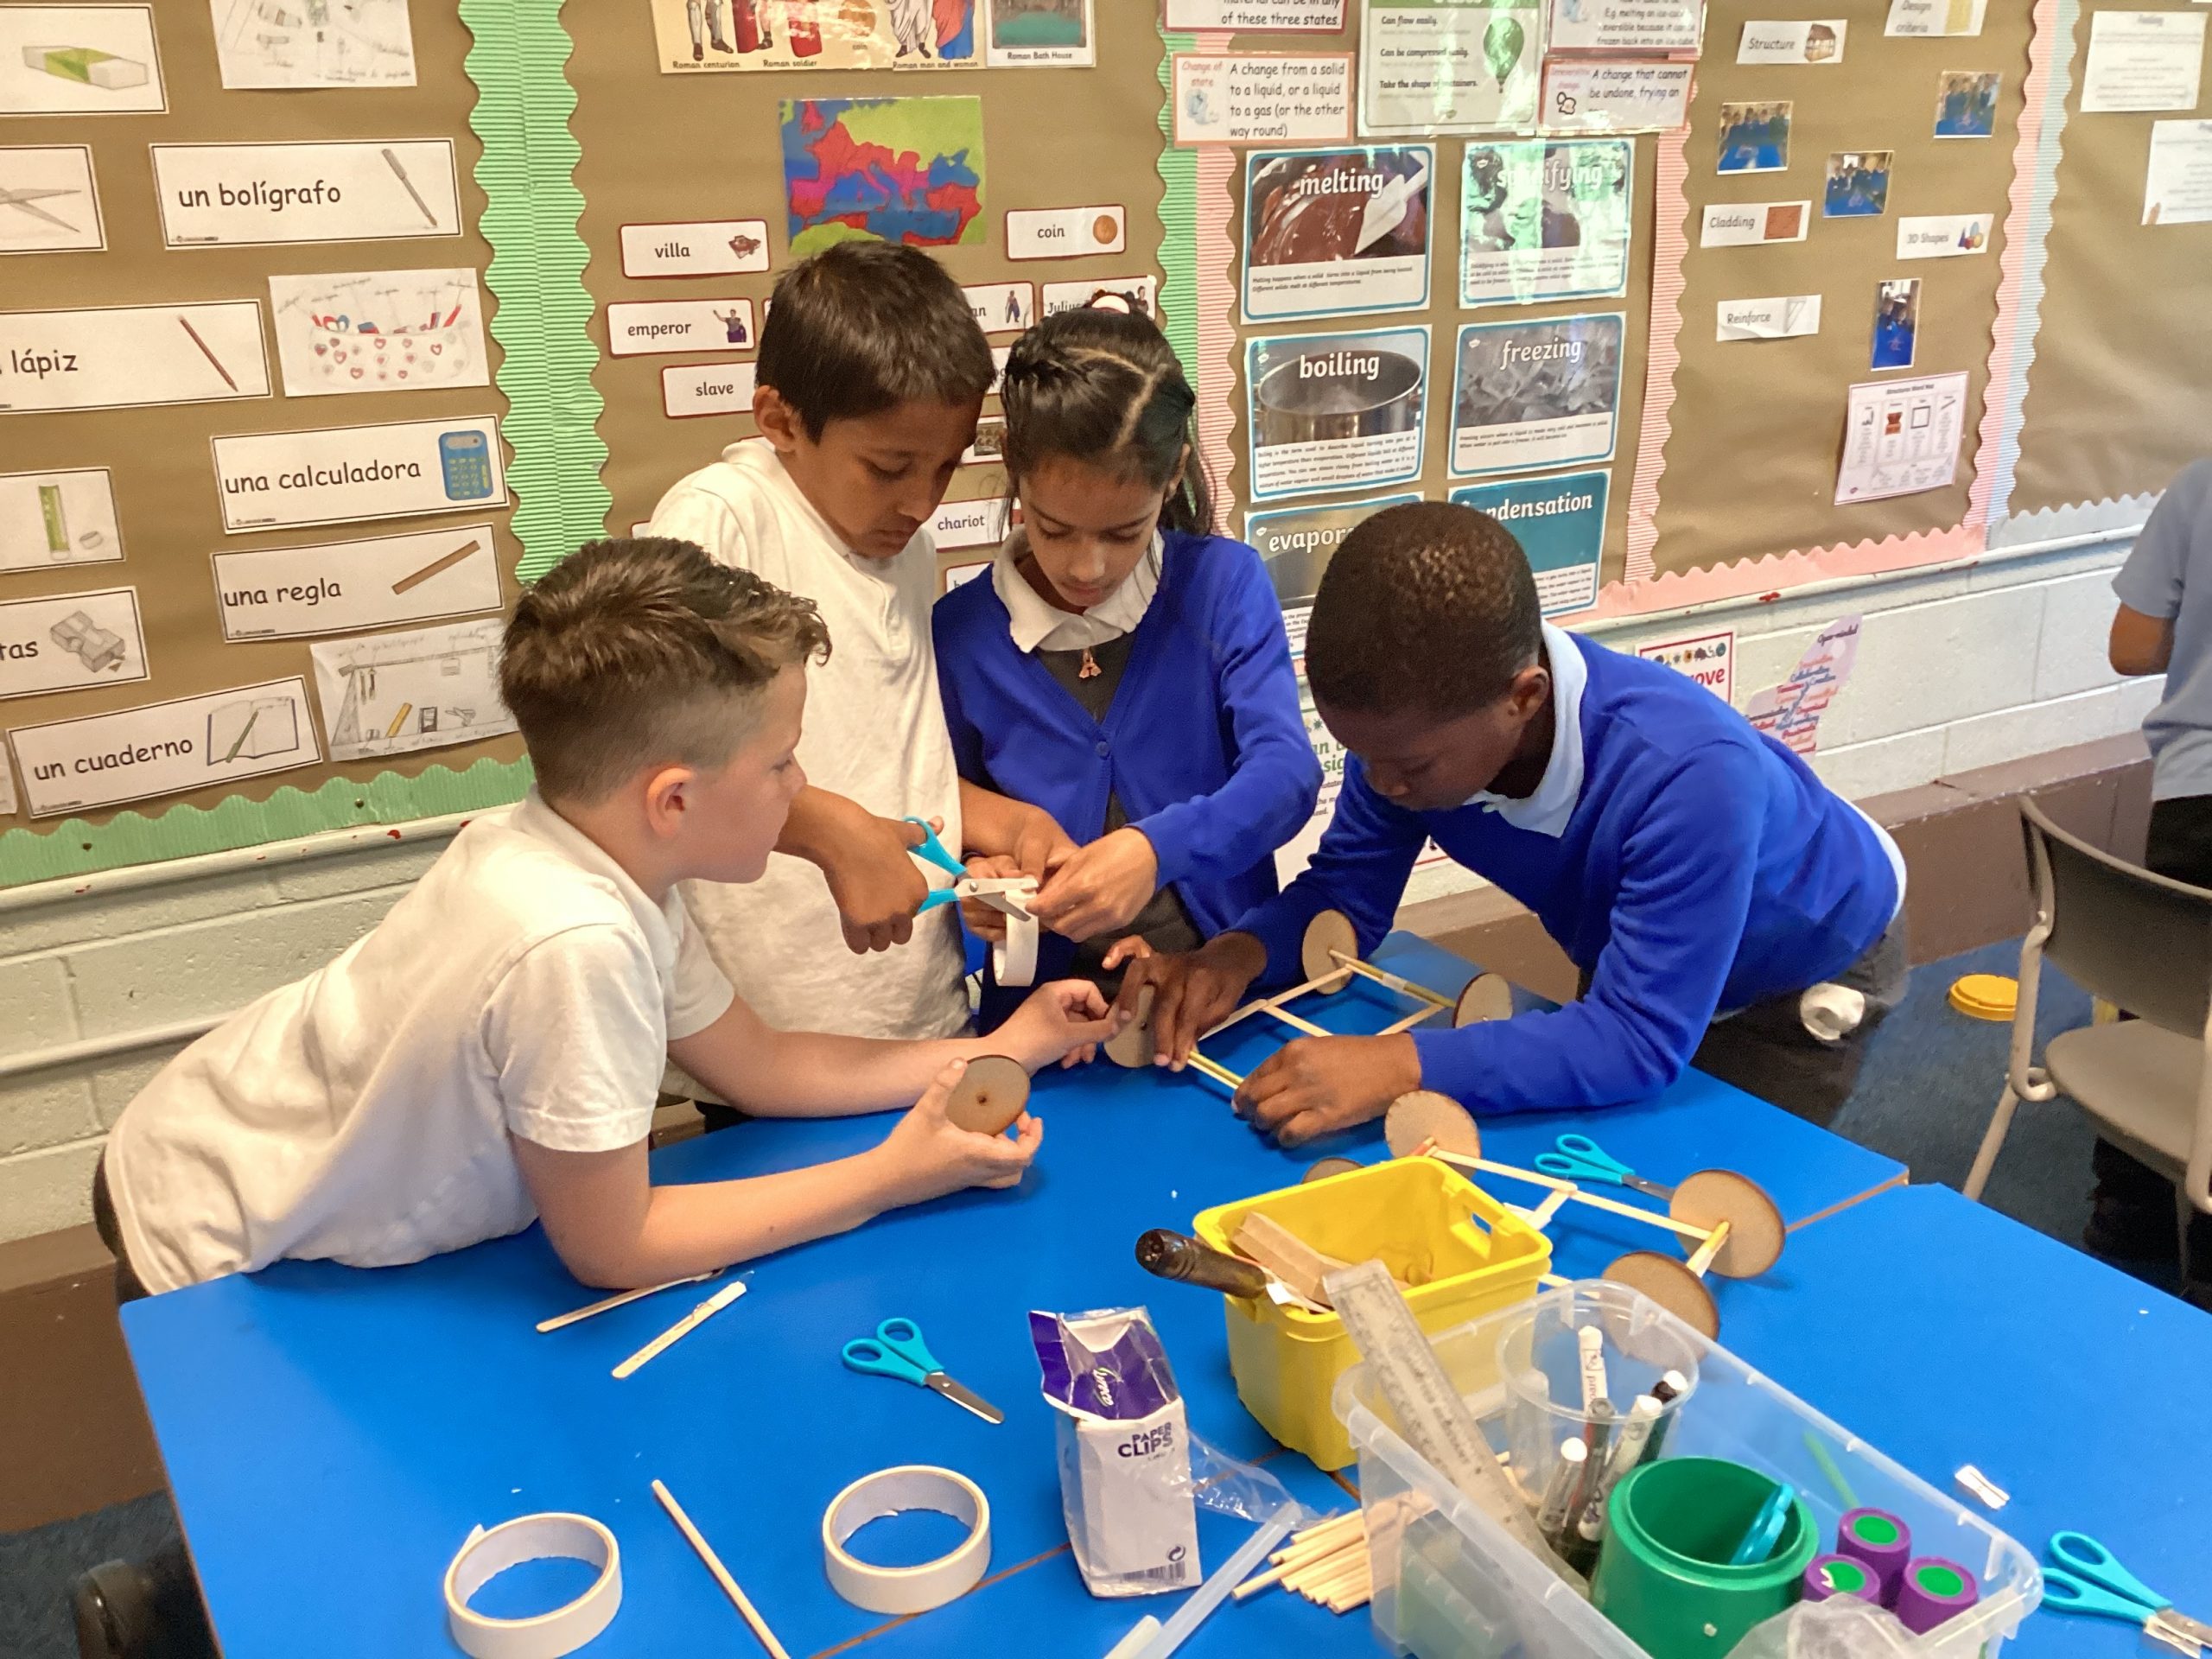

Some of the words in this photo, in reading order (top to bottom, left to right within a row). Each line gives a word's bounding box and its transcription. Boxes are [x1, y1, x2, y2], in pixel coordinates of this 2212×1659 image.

[1221, 11, 1234, 24] of
[1237, 11, 1268, 24] these
[1271, 12, 1300, 25] three
[1748, 38, 1796, 50] Structure
[672, 60, 702, 69] Roman
[1230, 64, 1238, 75] A
[1241, 63, 1279, 79] change
[1282, 62, 1307, 75] from
[1311, 67, 1318, 75] a
[1320, 62, 1345, 75] solid
[1230, 86, 1241, 96] to
[1313, 85, 1340, 99] liquid
[1230, 105, 1241, 116] to
[1254, 107, 1272, 121] gas
[1275, 105, 1291, 118] (or
[1294, 105, 1312, 116] the
[1315, 105, 1344, 116] other
[1230, 127, 1250, 139] way
[1253, 124, 1287, 137] round)
[1299, 167, 1384, 200] melting
[179, 190, 211, 208] un
[219, 179, 341, 213] bolígrafo
[1037, 224, 1065, 238] coin
[1709, 215, 1755, 230] Cladding
[654, 242, 691, 258] villa
[1726, 312, 1771, 327] Reinforce
[627, 322, 691, 340] emperor
[1499, 336, 1582, 371] freezing
[11, 347, 79, 380] lápiz
[1299, 352, 1380, 381] boiling
[696, 381, 734, 397] slave
[225, 475, 270, 494] una
[278, 459, 422, 489] calculadora
[1484, 492, 1593, 521] ndensation
[938, 514, 985, 531] chariot
[1268, 525, 1354, 553] evapor
[224, 589, 269, 607] una
[276, 577, 342, 607] regla
[1692, 667, 1726, 685] ove
[34, 761, 66, 781] un
[74, 739, 194, 774] cuaderno
[1132, 1421, 1172, 1442] PAPER
[1118, 1432, 1173, 1458] CLIPS
